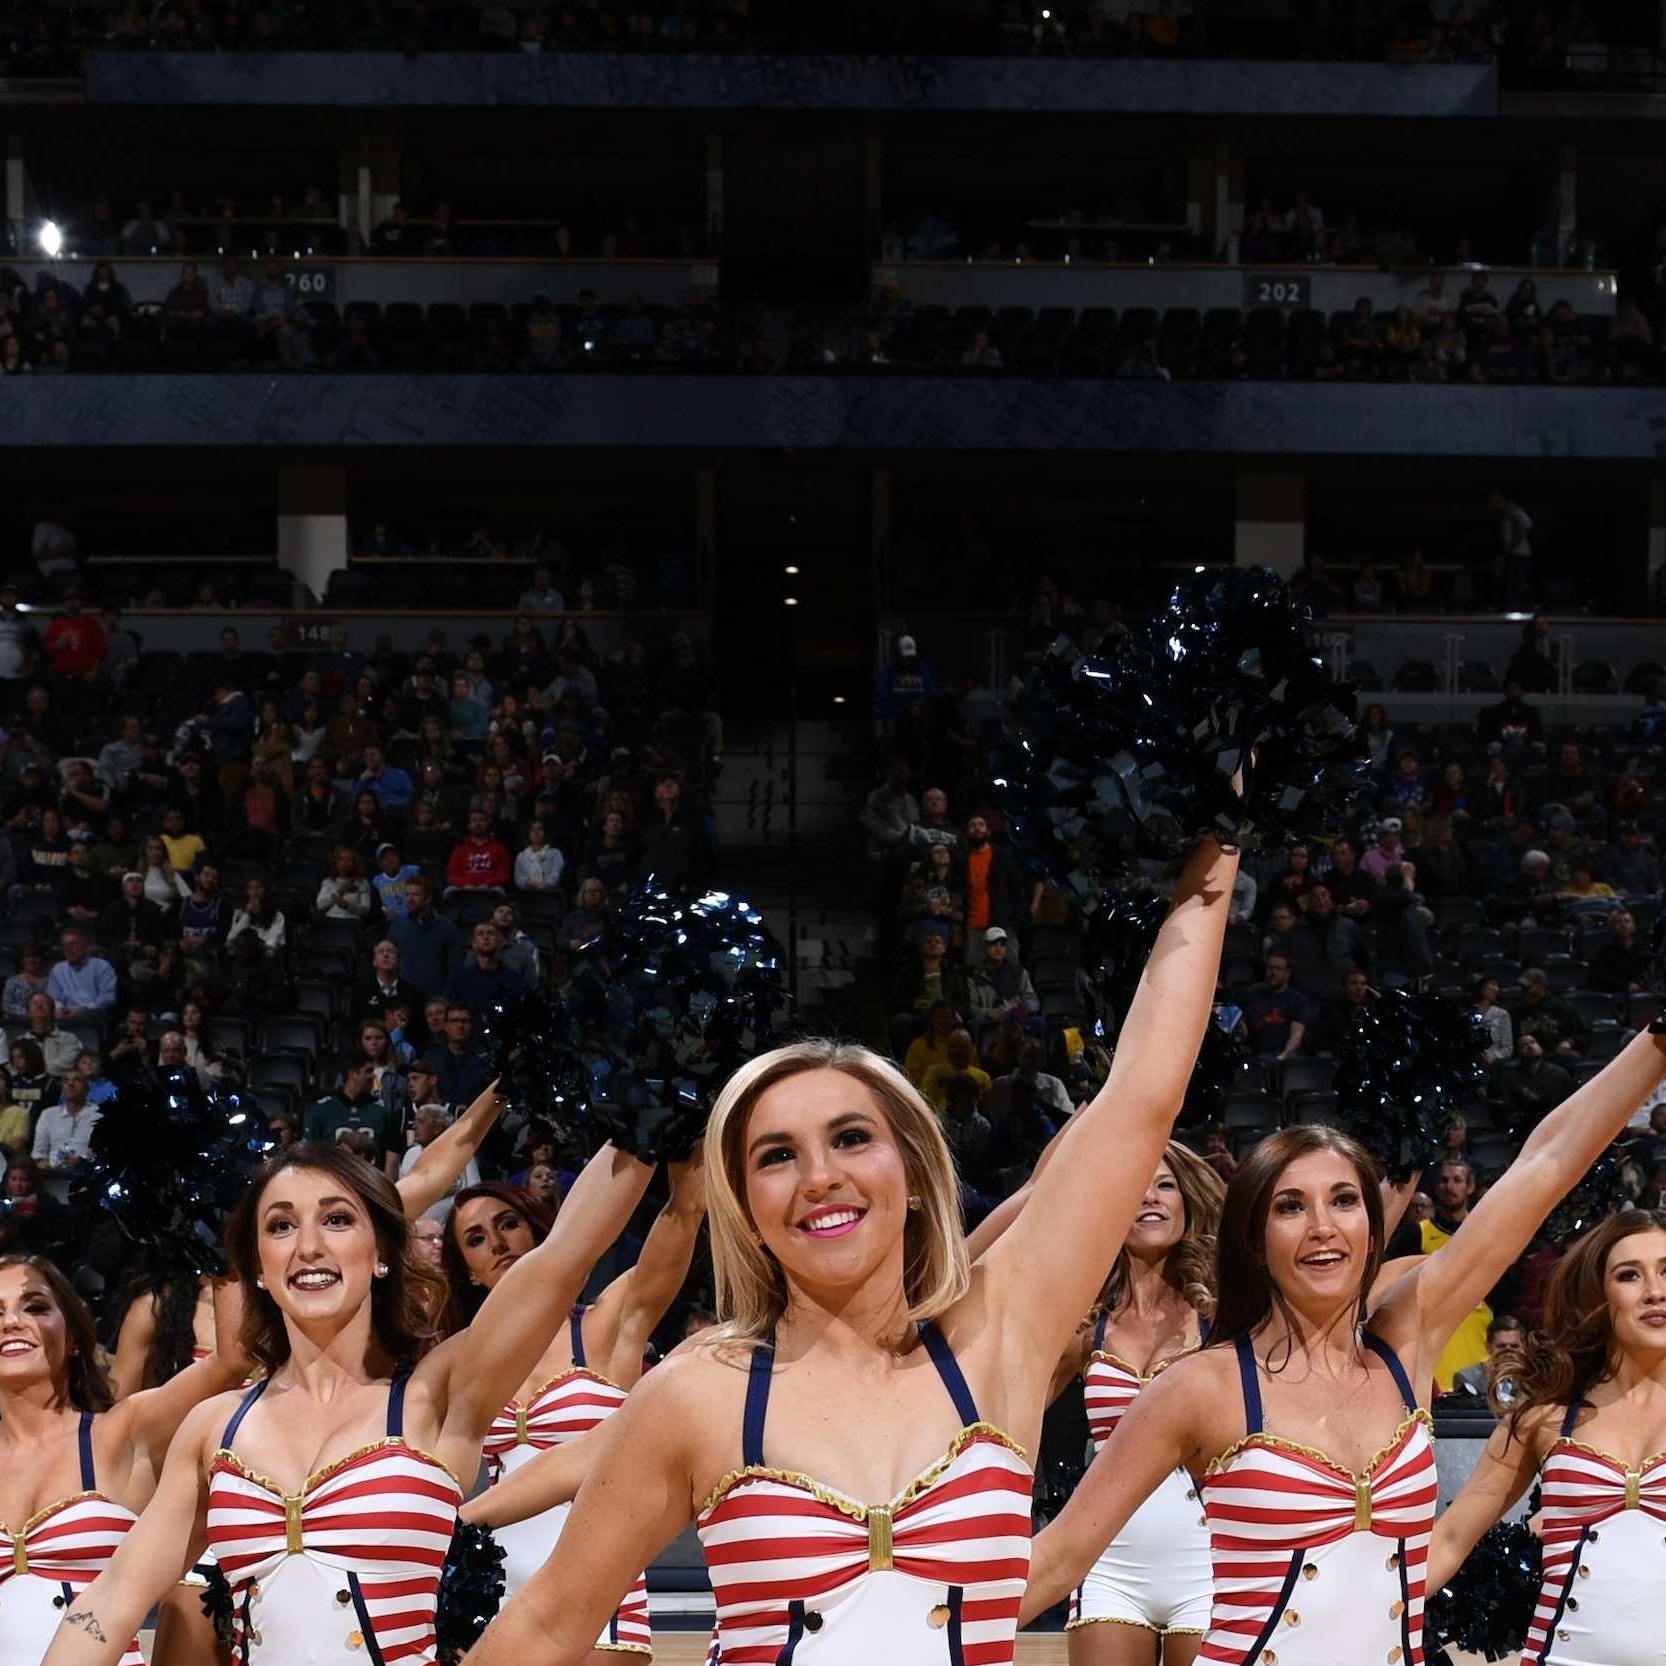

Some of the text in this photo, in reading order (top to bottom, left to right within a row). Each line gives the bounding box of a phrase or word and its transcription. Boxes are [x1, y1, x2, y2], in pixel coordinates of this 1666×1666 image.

[1258, 282, 1300, 302] 202
[297, 625, 331, 642] 148
[1313, 632, 1342, 648] 10
